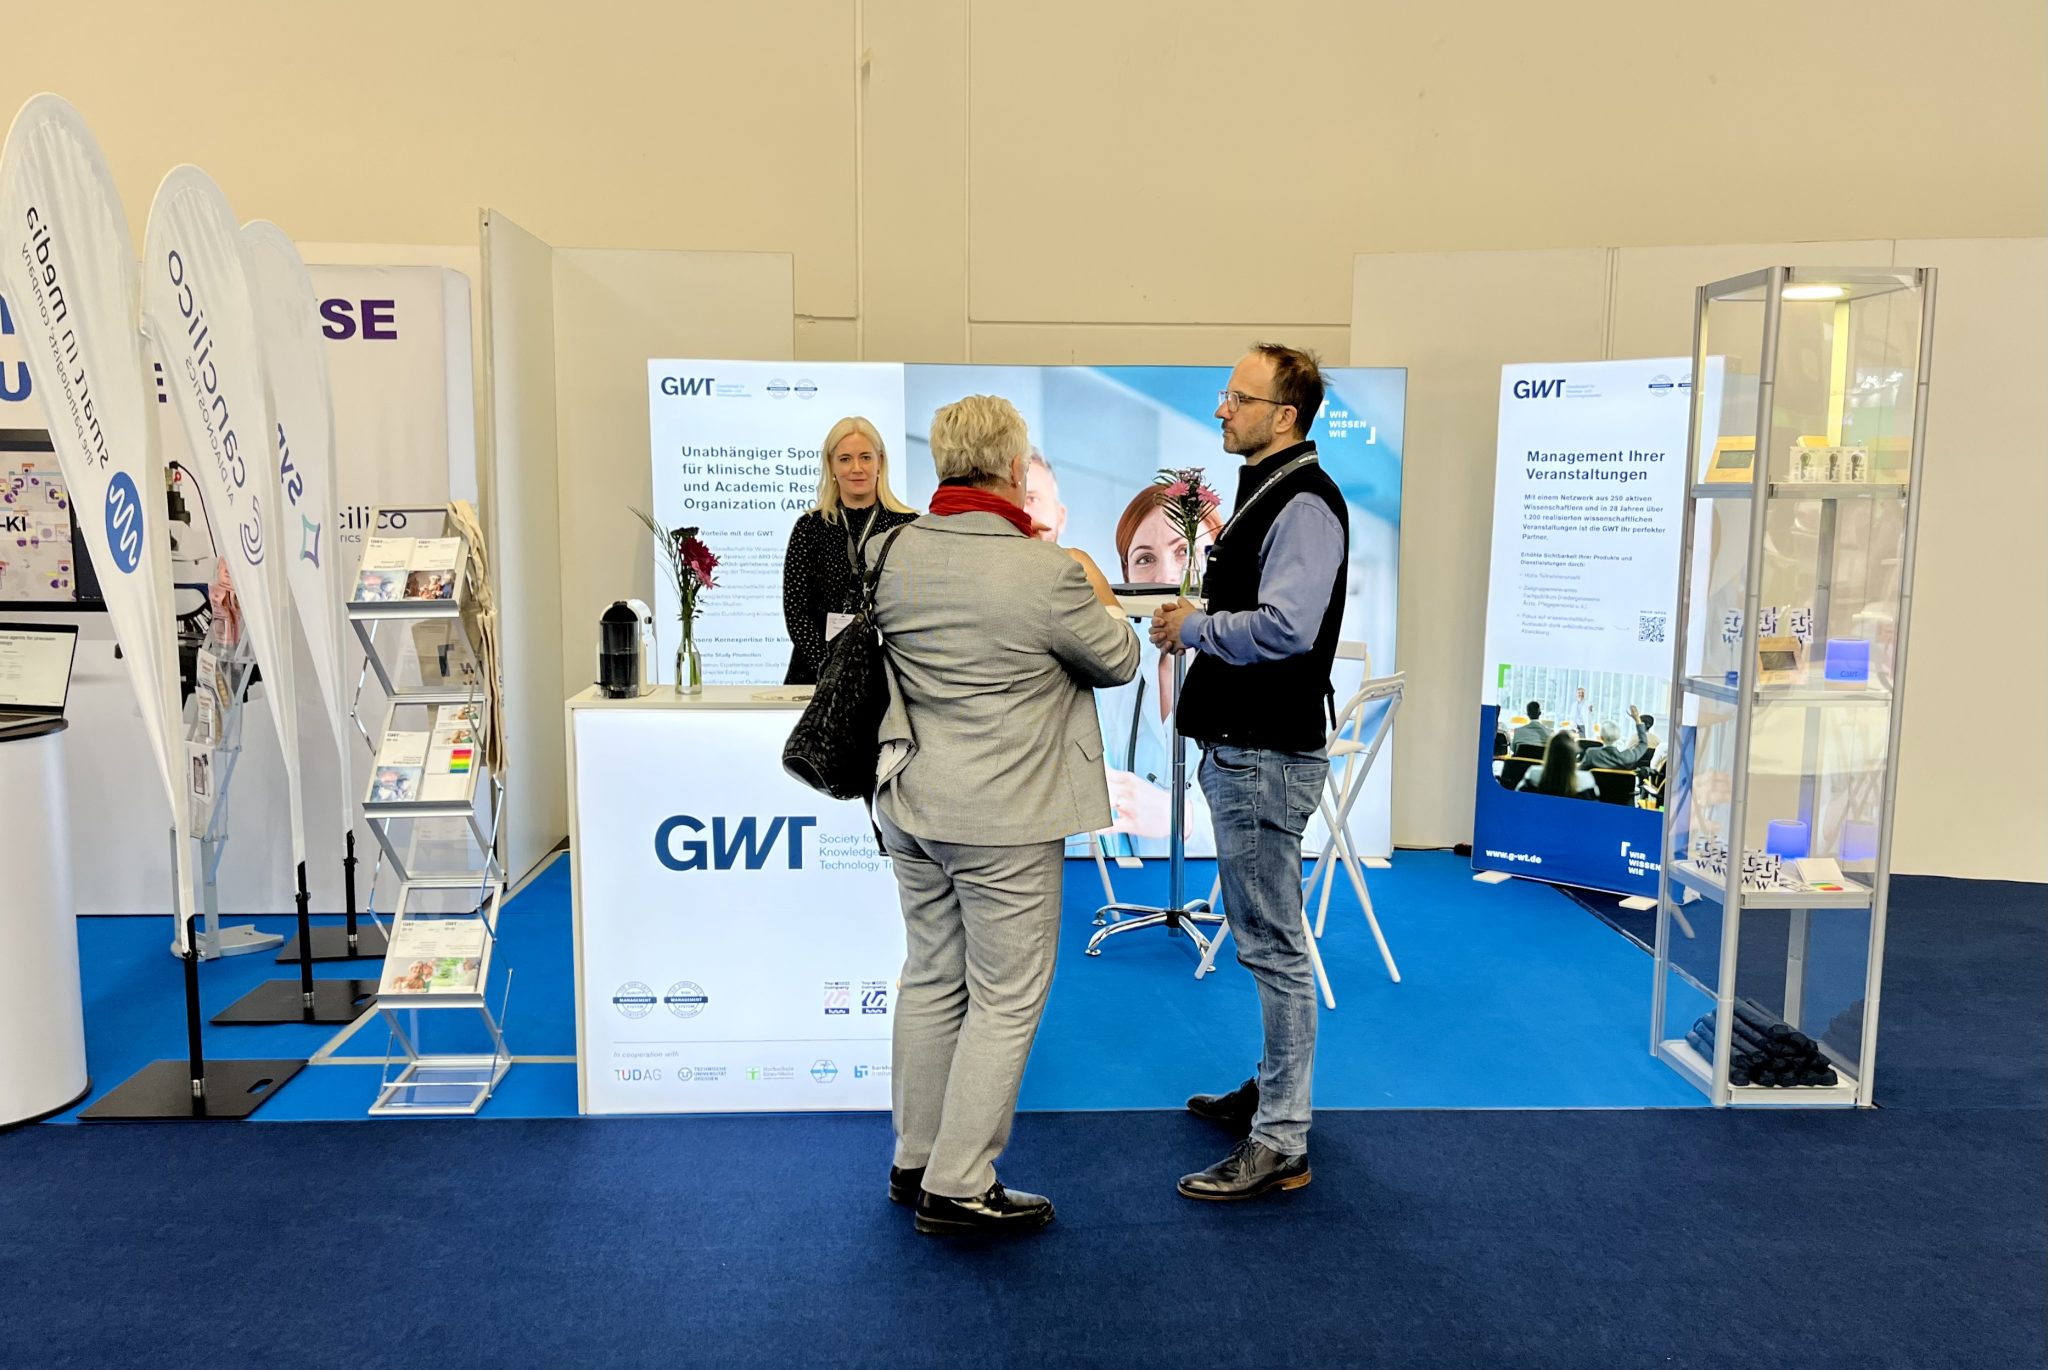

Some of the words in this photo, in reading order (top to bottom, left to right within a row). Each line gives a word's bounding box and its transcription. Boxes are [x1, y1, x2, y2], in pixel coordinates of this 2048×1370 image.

[320, 298, 398, 341] SE
[661, 376, 715, 396] GWT
[1513, 378, 1566, 399] GWT
[1328, 420, 1366, 428] WISSEN
[1328, 430, 1347, 438] WIE
[682, 446, 782, 460] Unabhängiger
[1527, 450, 1623, 464] Management
[1628, 450, 1665, 462] Ihrer
[682, 463, 702, 475] für
[707, 463, 770, 475] klinische
[1526, 468, 1648, 483] Veranstaltungen
[683, 481, 710, 492] und
[714, 481, 784, 493] Academic
[789, 482, 818, 493] Res
[684, 498, 776, 511] Organization
[654, 814, 817, 872] GWT
[819, 833, 859, 846] Society
[1485, 849, 1542, 864] www.g-wt.de
[1629, 851, 1646, 861] WIR
[820, 860, 880, 872] Technology
[1627, 867, 1644, 876] WIE
